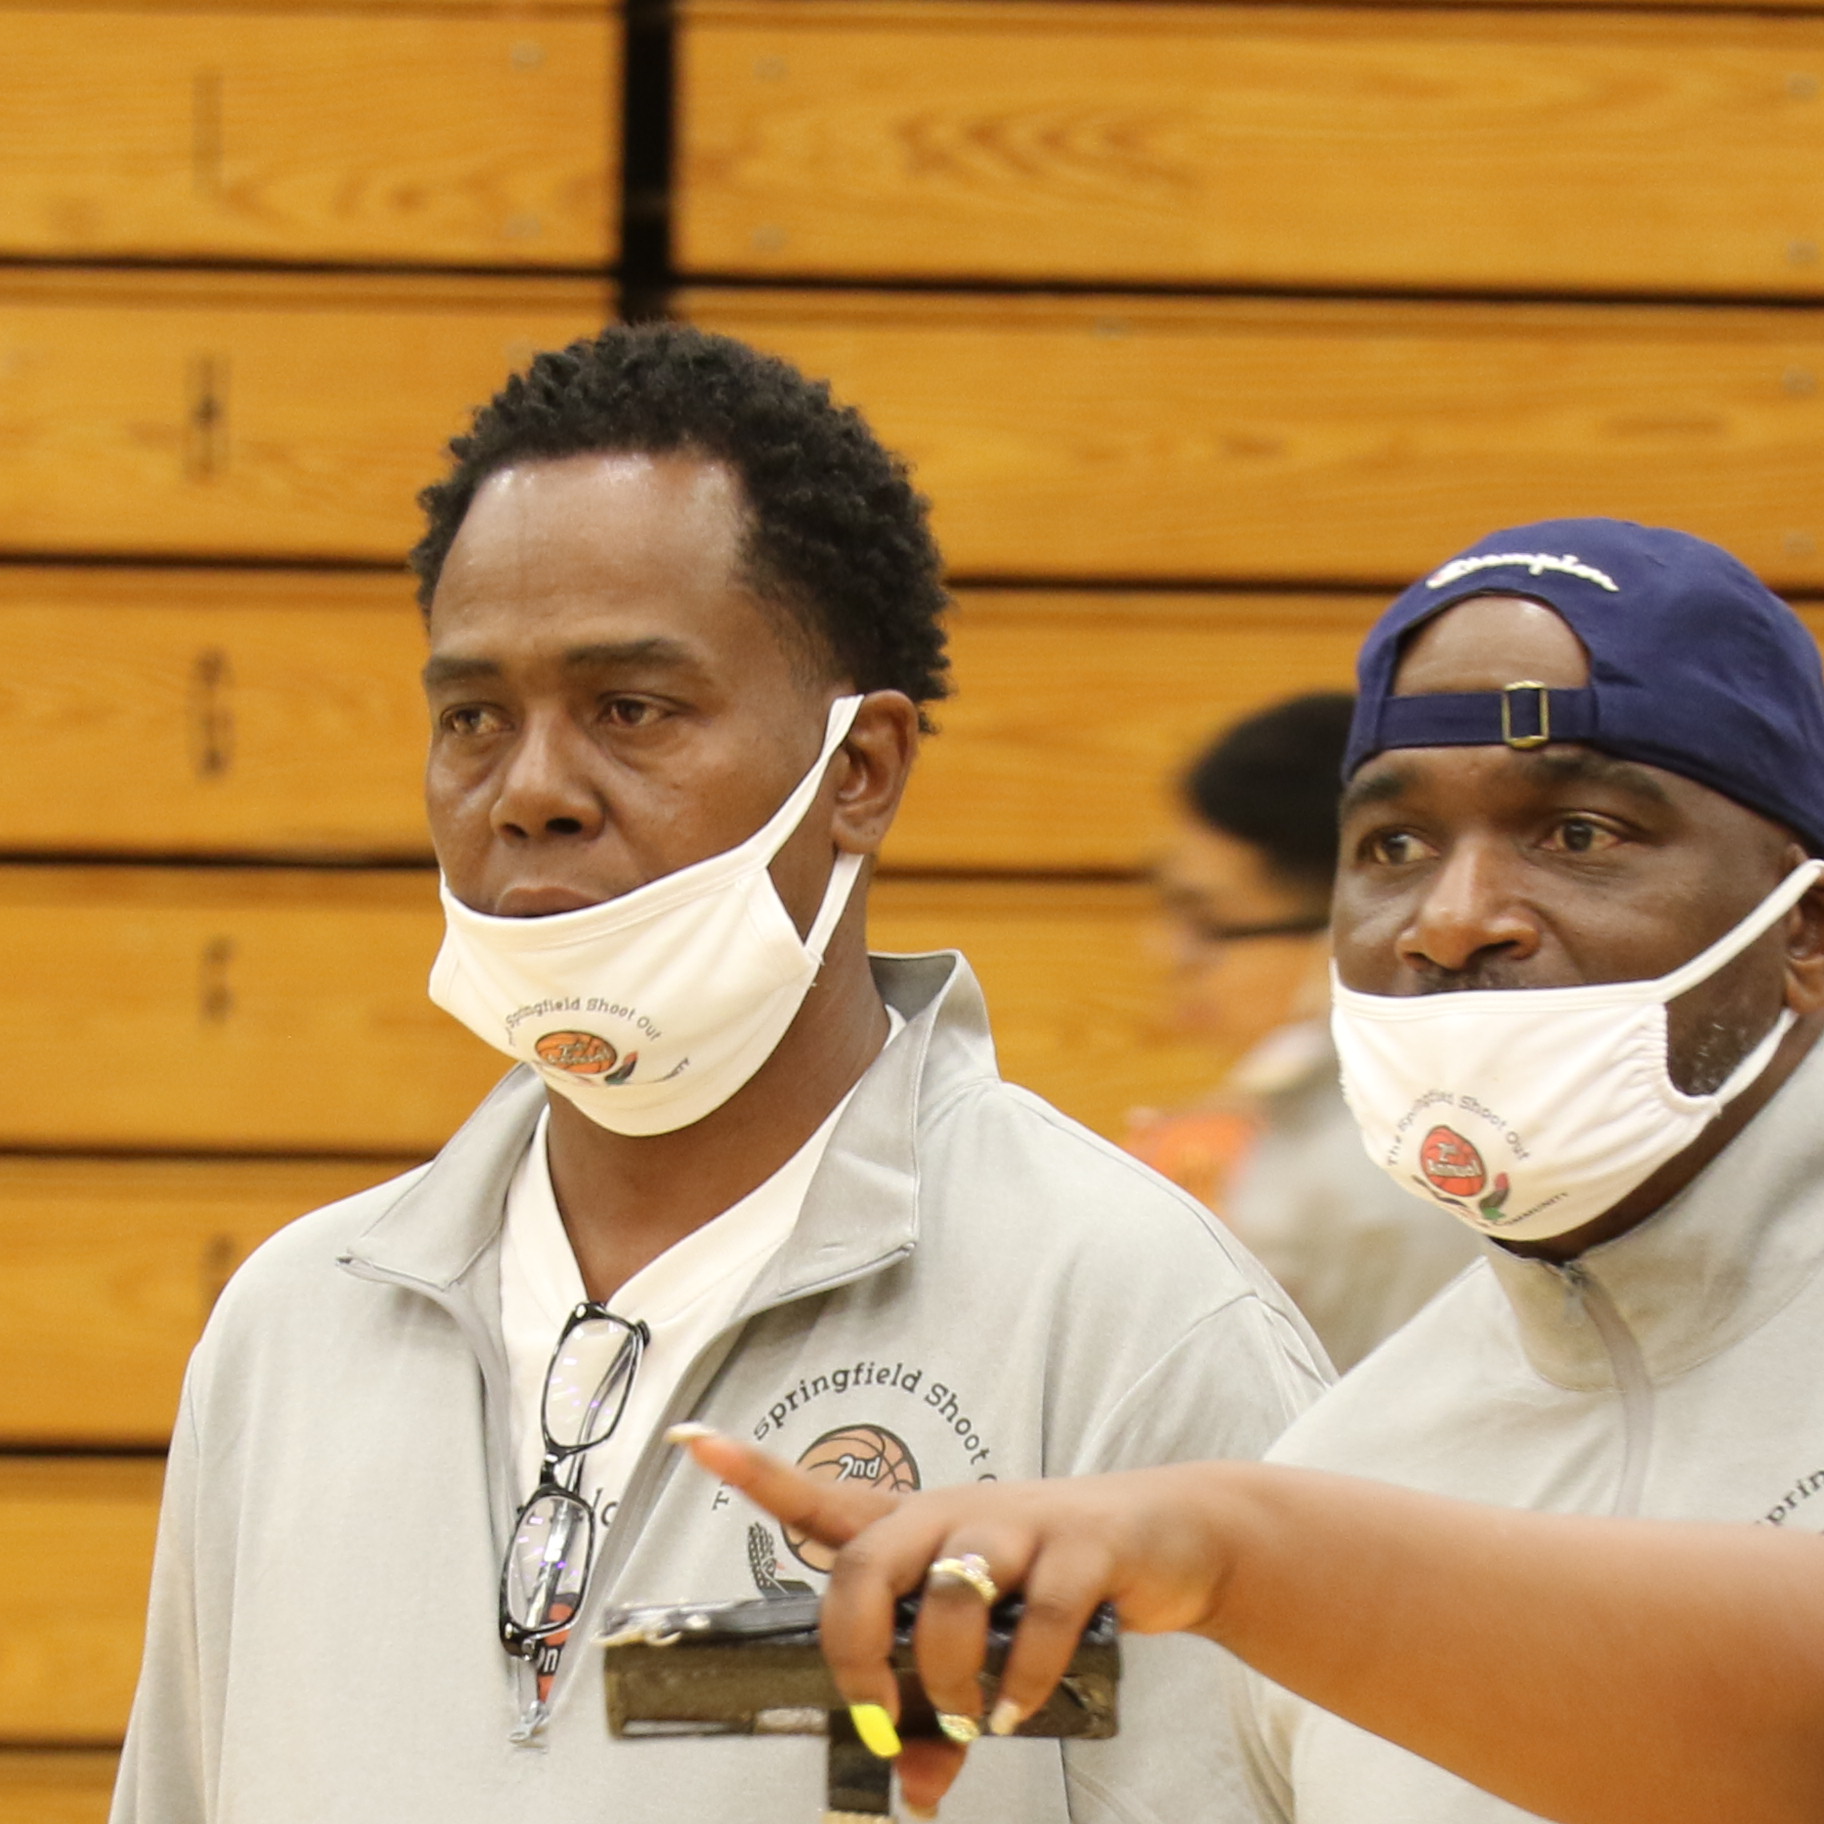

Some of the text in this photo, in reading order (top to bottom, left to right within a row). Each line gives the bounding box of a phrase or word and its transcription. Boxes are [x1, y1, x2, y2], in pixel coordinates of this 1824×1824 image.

[586, 998, 636, 1021] Shoot
[636, 1016, 662, 1042] Out
[1505, 1131, 1531, 1161] Out
[753, 1361, 990, 1466] Springfield Shoot
[835, 1454, 881, 1482] 2nd
